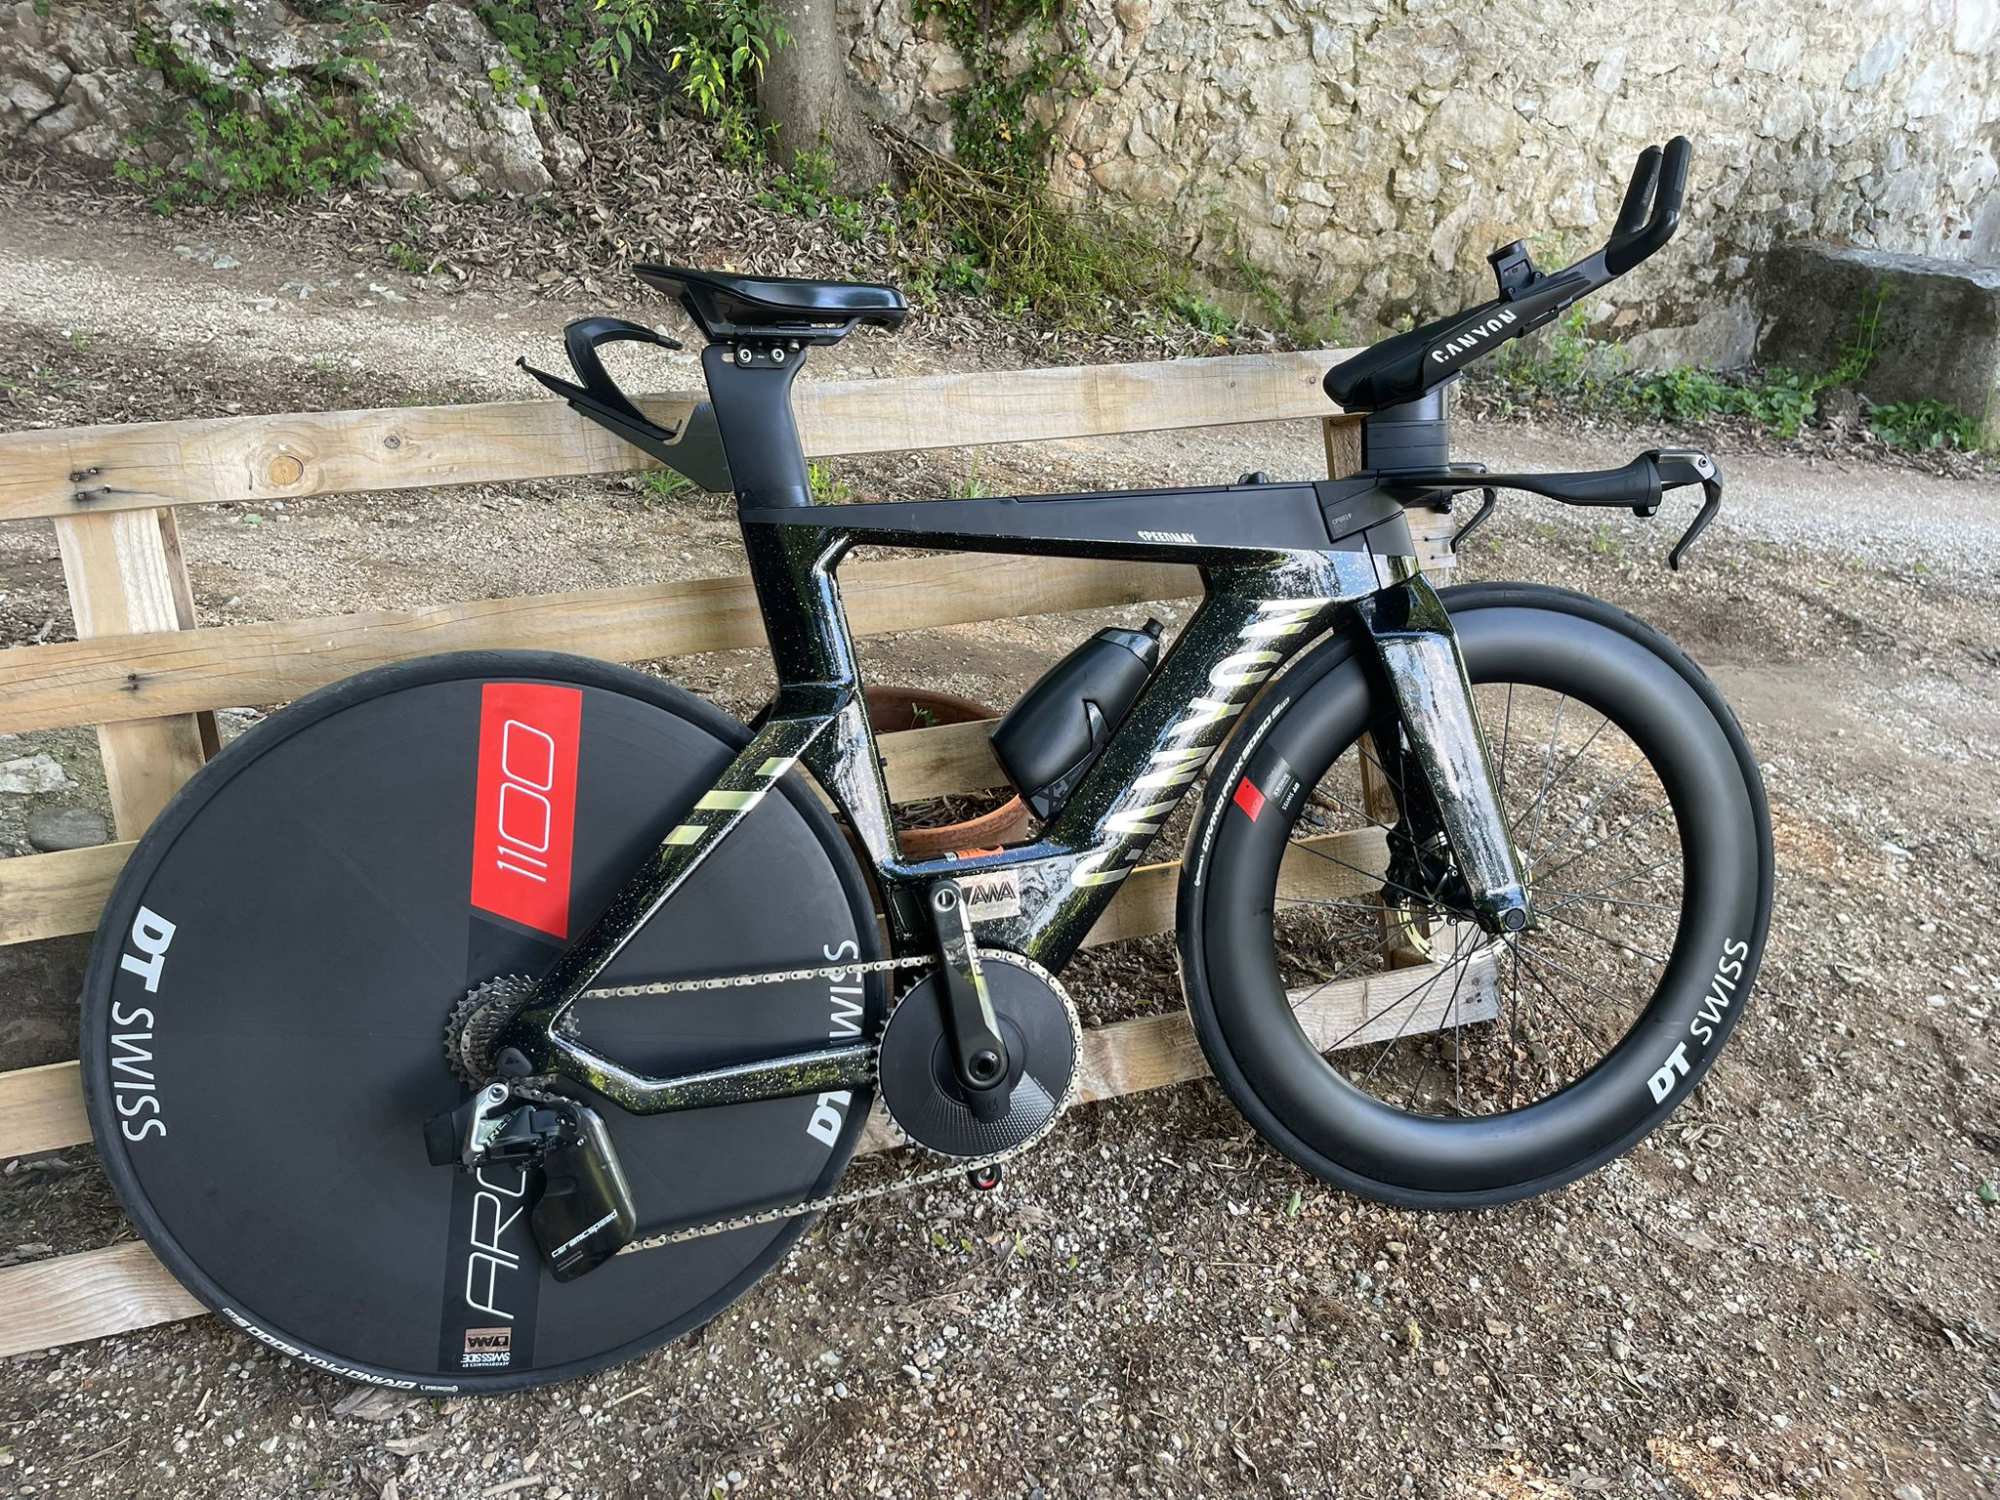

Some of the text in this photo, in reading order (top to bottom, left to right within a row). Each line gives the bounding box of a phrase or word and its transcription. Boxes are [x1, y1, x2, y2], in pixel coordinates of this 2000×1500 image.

[1431, 309, 1517, 363] CANYON
[1070, 599, 1332, 888] CANYON
[1222, 755, 1244, 798] PRIX
[1241, 714, 1272, 760] 5000
[496, 719, 555, 883] 1100
[111, 905, 177, 1142] DT SWISS
[823, 939, 864, 1039] WIS
[1647, 938, 1748, 1104] DT SWISS
[246, 1326, 302, 1357] 5000
[298, 1353, 350, 1375] PRIX
